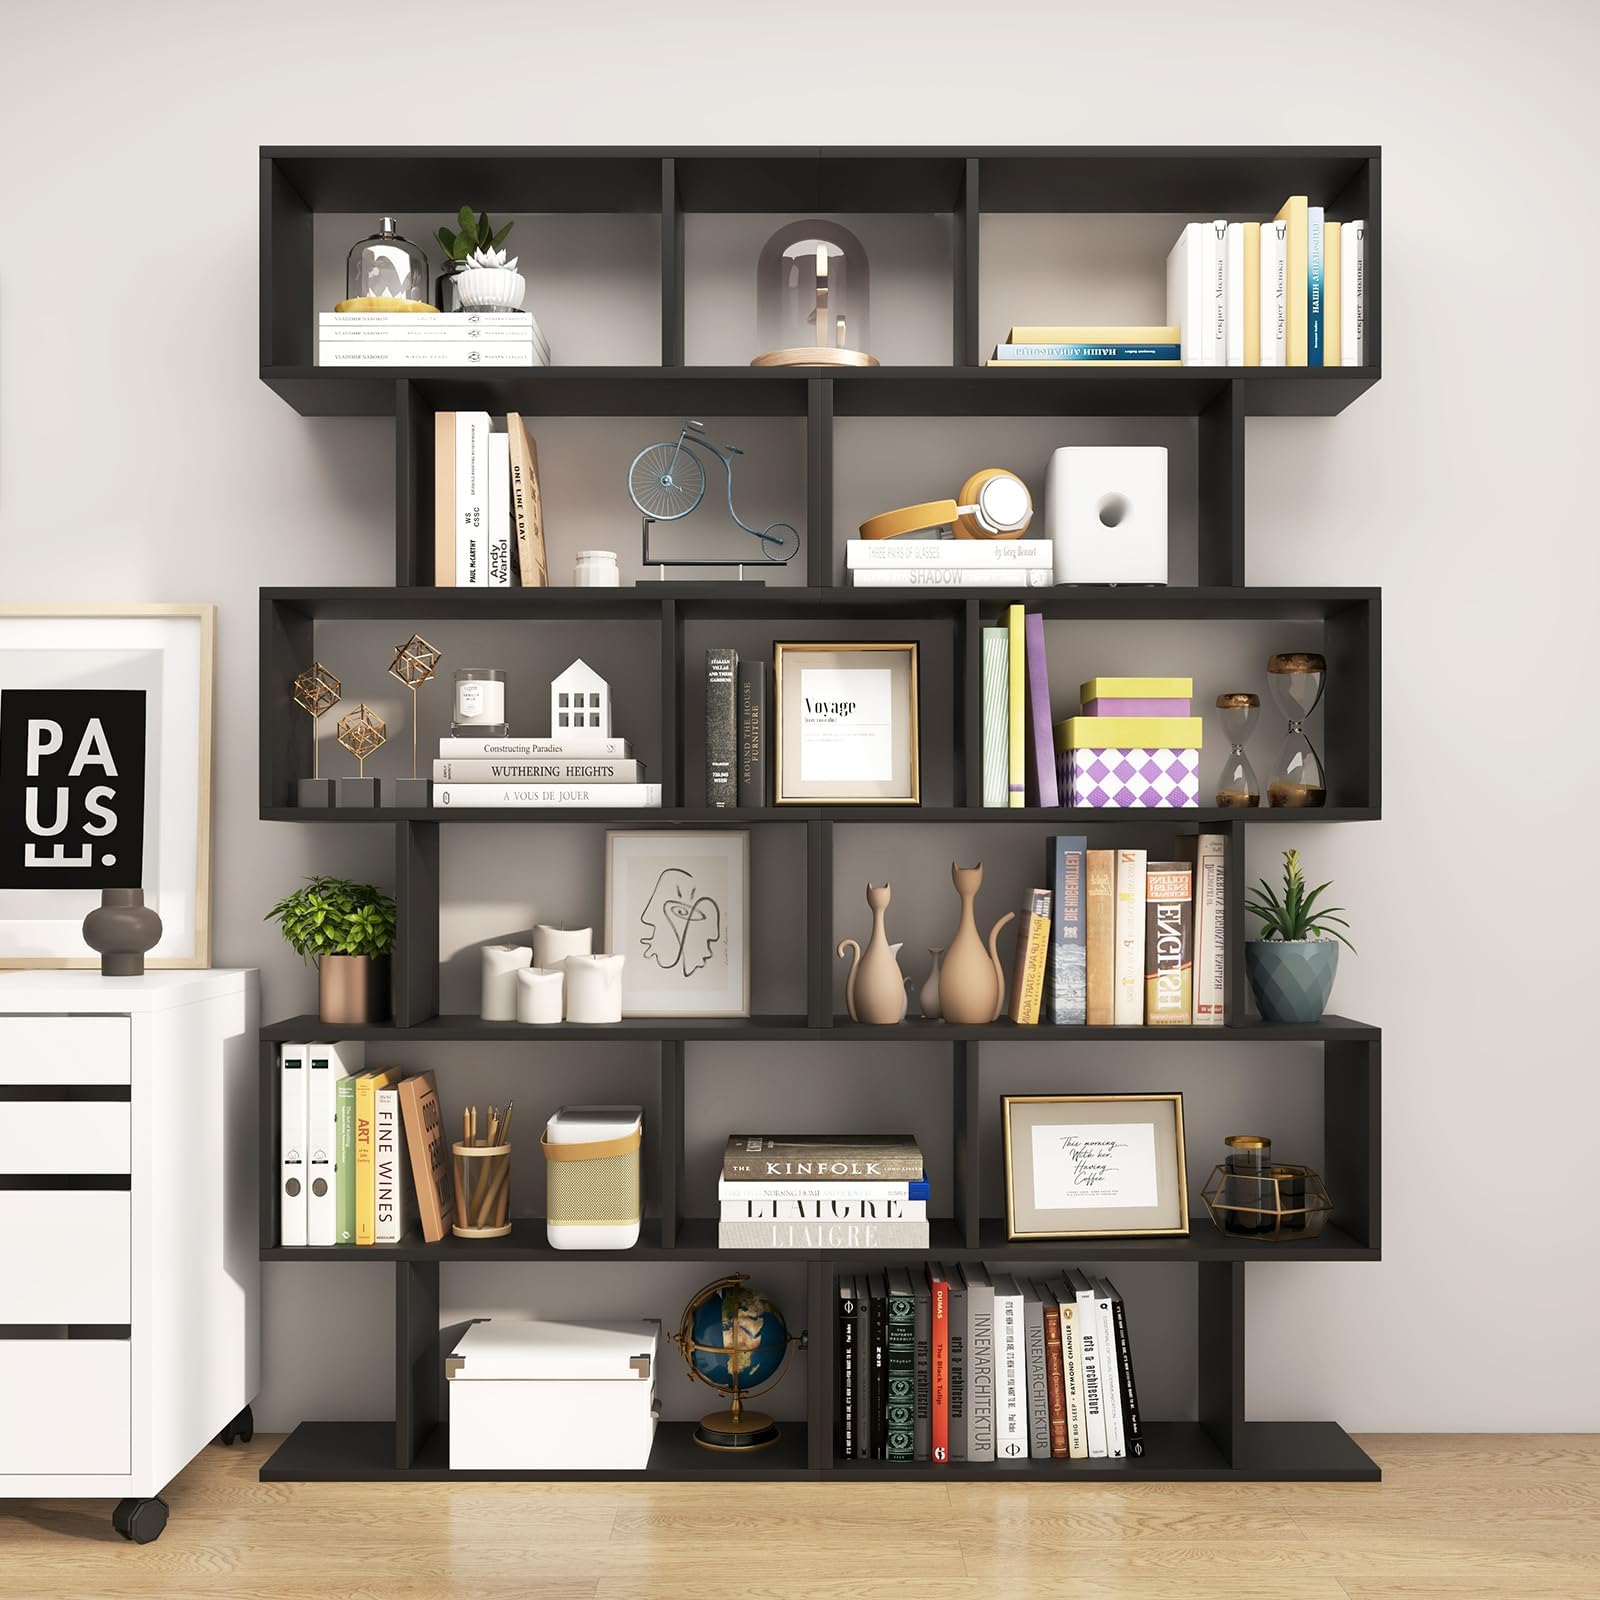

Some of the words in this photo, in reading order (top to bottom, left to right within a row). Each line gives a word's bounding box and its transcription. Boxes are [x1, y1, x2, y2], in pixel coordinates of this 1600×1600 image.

[1312, 284, 1320, 314] НАШИ
[1083, 348, 1117, 356] НАШИ
[515, 489, 524, 510] LINE
[465, 512, 471, 524] WS
[490, 544, 501, 578] Andy
[499, 539, 507, 584] Warhol
[909, 569, 964, 584] SHADOW
[743, 682, 751, 716] HOUSE
[805, 697, 856, 717] Voyage
[743, 719, 751, 739] THE
[751, 704, 759, 761] FURNITURE
[483, 744, 531, 756] Constructing
[532, 744, 563, 755] Paradies
[491, 766, 561, 777] WUTHERING
[565, 766, 614, 777] HEIGHTS
[743, 742, 751, 784] AROUND
[503, 791, 510, 801] A
[514, 791, 539, 801] VOUS
[542, 791, 555, 801] DE
[558, 791, 590, 803] JOUER
[358, 1118, 370, 1144] ART
[378, 1111, 393, 1153] FINE
[1059, 1136, 1082, 1150] This
[1069, 1146, 1095, 1162] With
[766, 1161, 882, 1175] KINFOLK
[1074, 1160, 1119, 1175] Having
[1074, 1171, 1105, 1186] Coffee
[378, 1162, 393, 1222] WINES
[772, 1225, 878, 1248] LIAIGRE
[918, 1340, 928, 1357] arts
[952, 1336, 963, 1353] arts
[1066, 1324, 1074, 1360] CHANDLER
[1083, 1335, 1094, 1352] arts
[974, 1313, 991, 1451] INNENARCHITEKTUR
[1030, 1325, 1048, 1449] INNENARCHITEKTUR
[1068, 1361, 1076, 1395] RAYMOND
[918, 1370, 928, 1419] architecture
[952, 1367, 964, 1418] architecture
[1086, 1364, 1099, 1415] architecture
[1071, 1403, 1079, 1422] SLEEP
